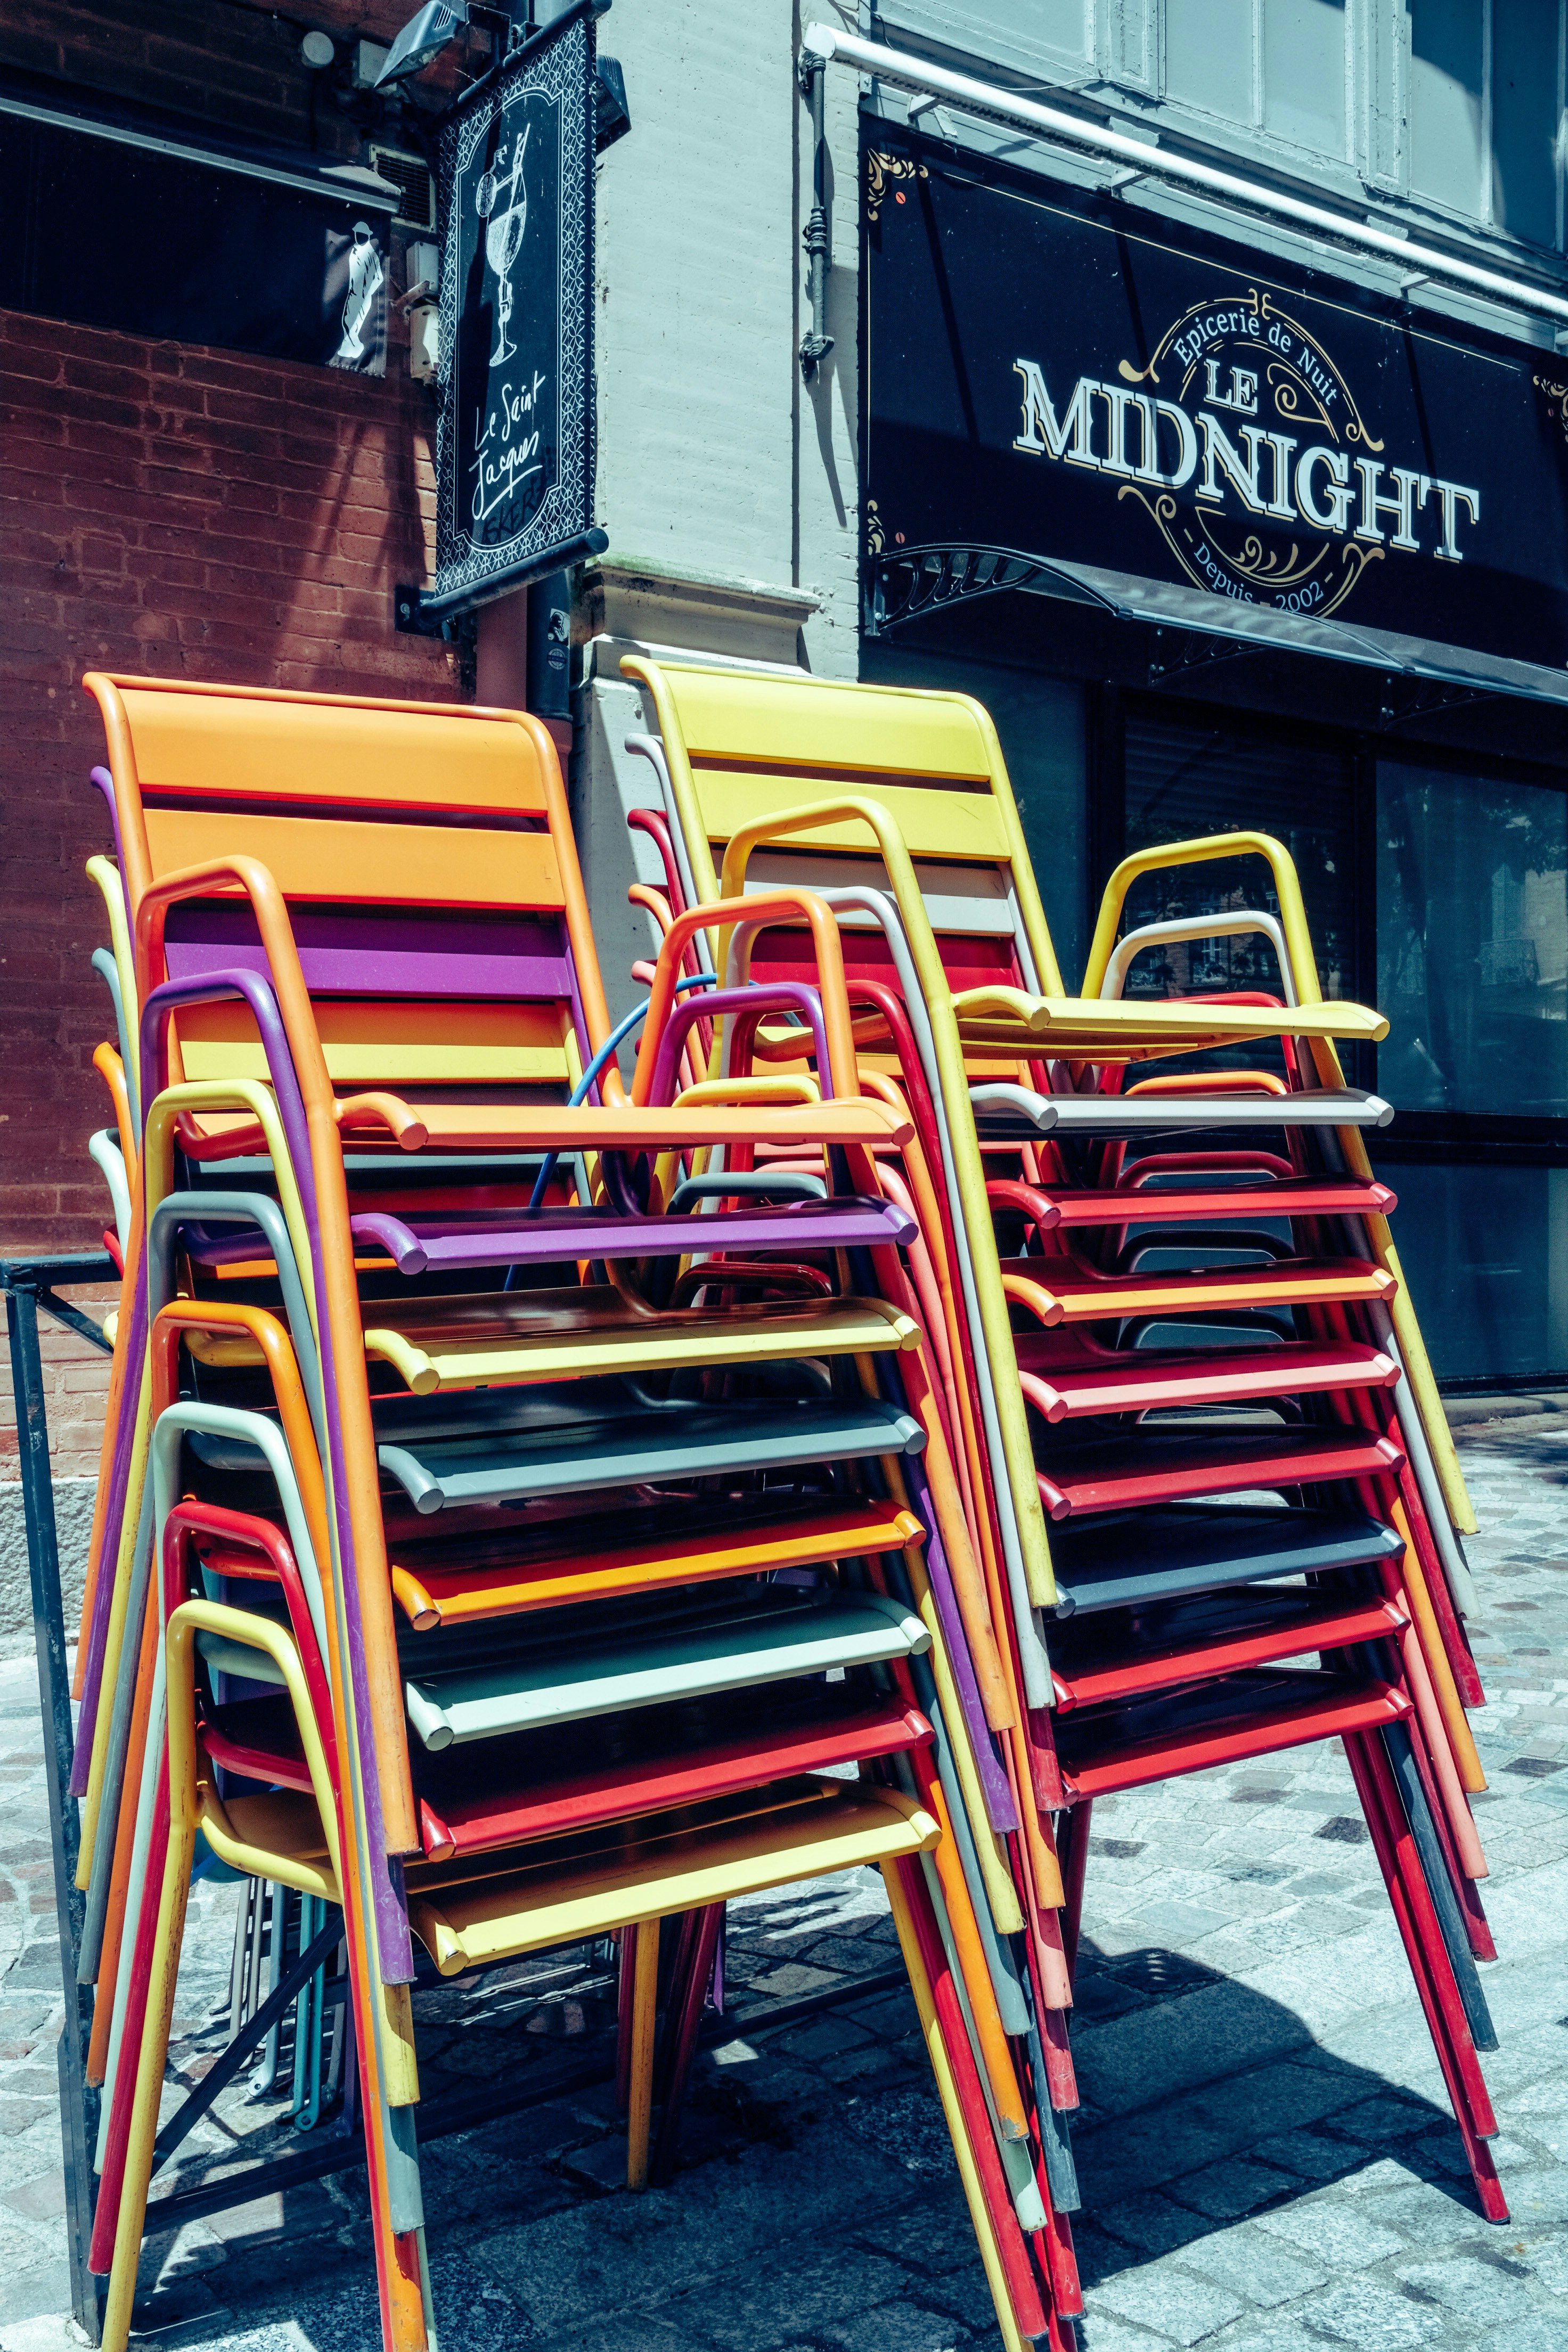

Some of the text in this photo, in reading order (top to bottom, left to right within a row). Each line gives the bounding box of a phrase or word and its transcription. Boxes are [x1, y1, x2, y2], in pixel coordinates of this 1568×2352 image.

[1173, 307, 1337, 406] Epicerie de Nuit
[1203, 358, 1257, 416] LE
[475, 370, 545, 451] Le Saint
[469, 430, 539, 520] Jacques
[1013, 358, 1480, 563] MIDNIGHT
[1194, 542, 1324, 612] Depuis 2002
